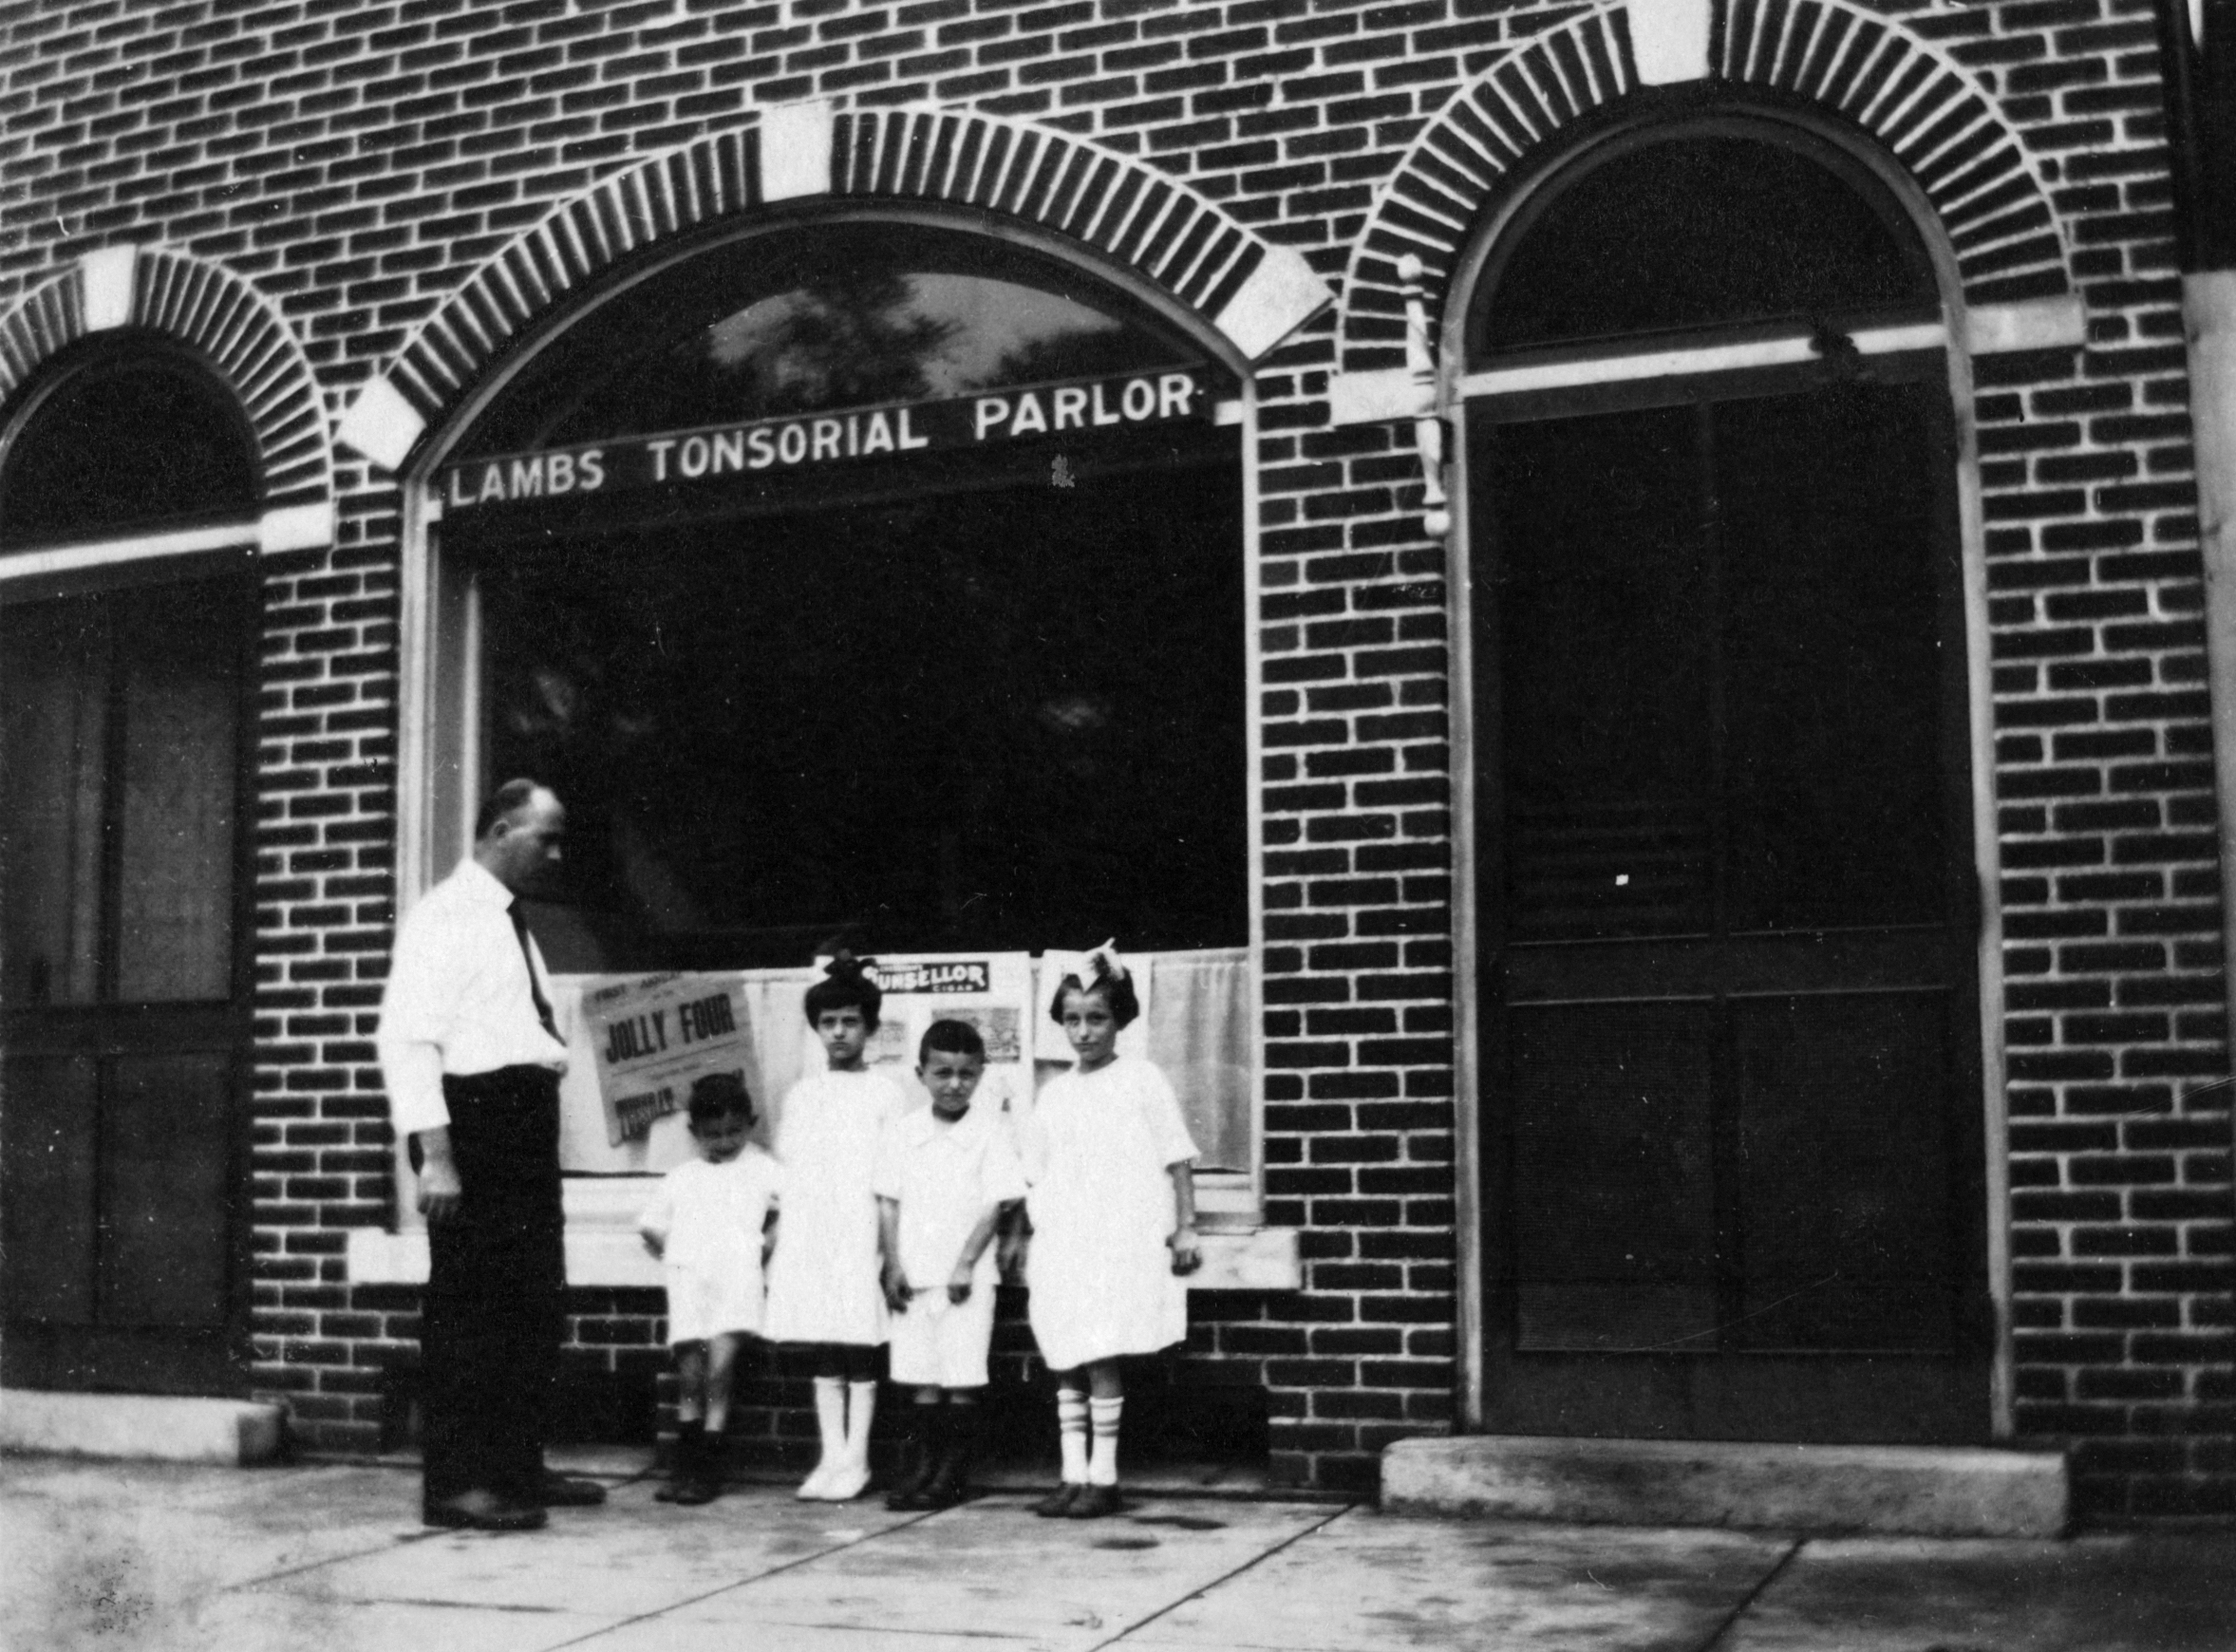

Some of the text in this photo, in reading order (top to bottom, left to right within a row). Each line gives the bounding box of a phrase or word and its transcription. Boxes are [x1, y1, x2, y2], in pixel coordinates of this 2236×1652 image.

[450, 373, 1194, 507] LAMBS TONSORIAL PARLOR
[861, 965, 986, 990] UNSELLOR
[605, 992, 737, 1064] JOLLY FOUR
